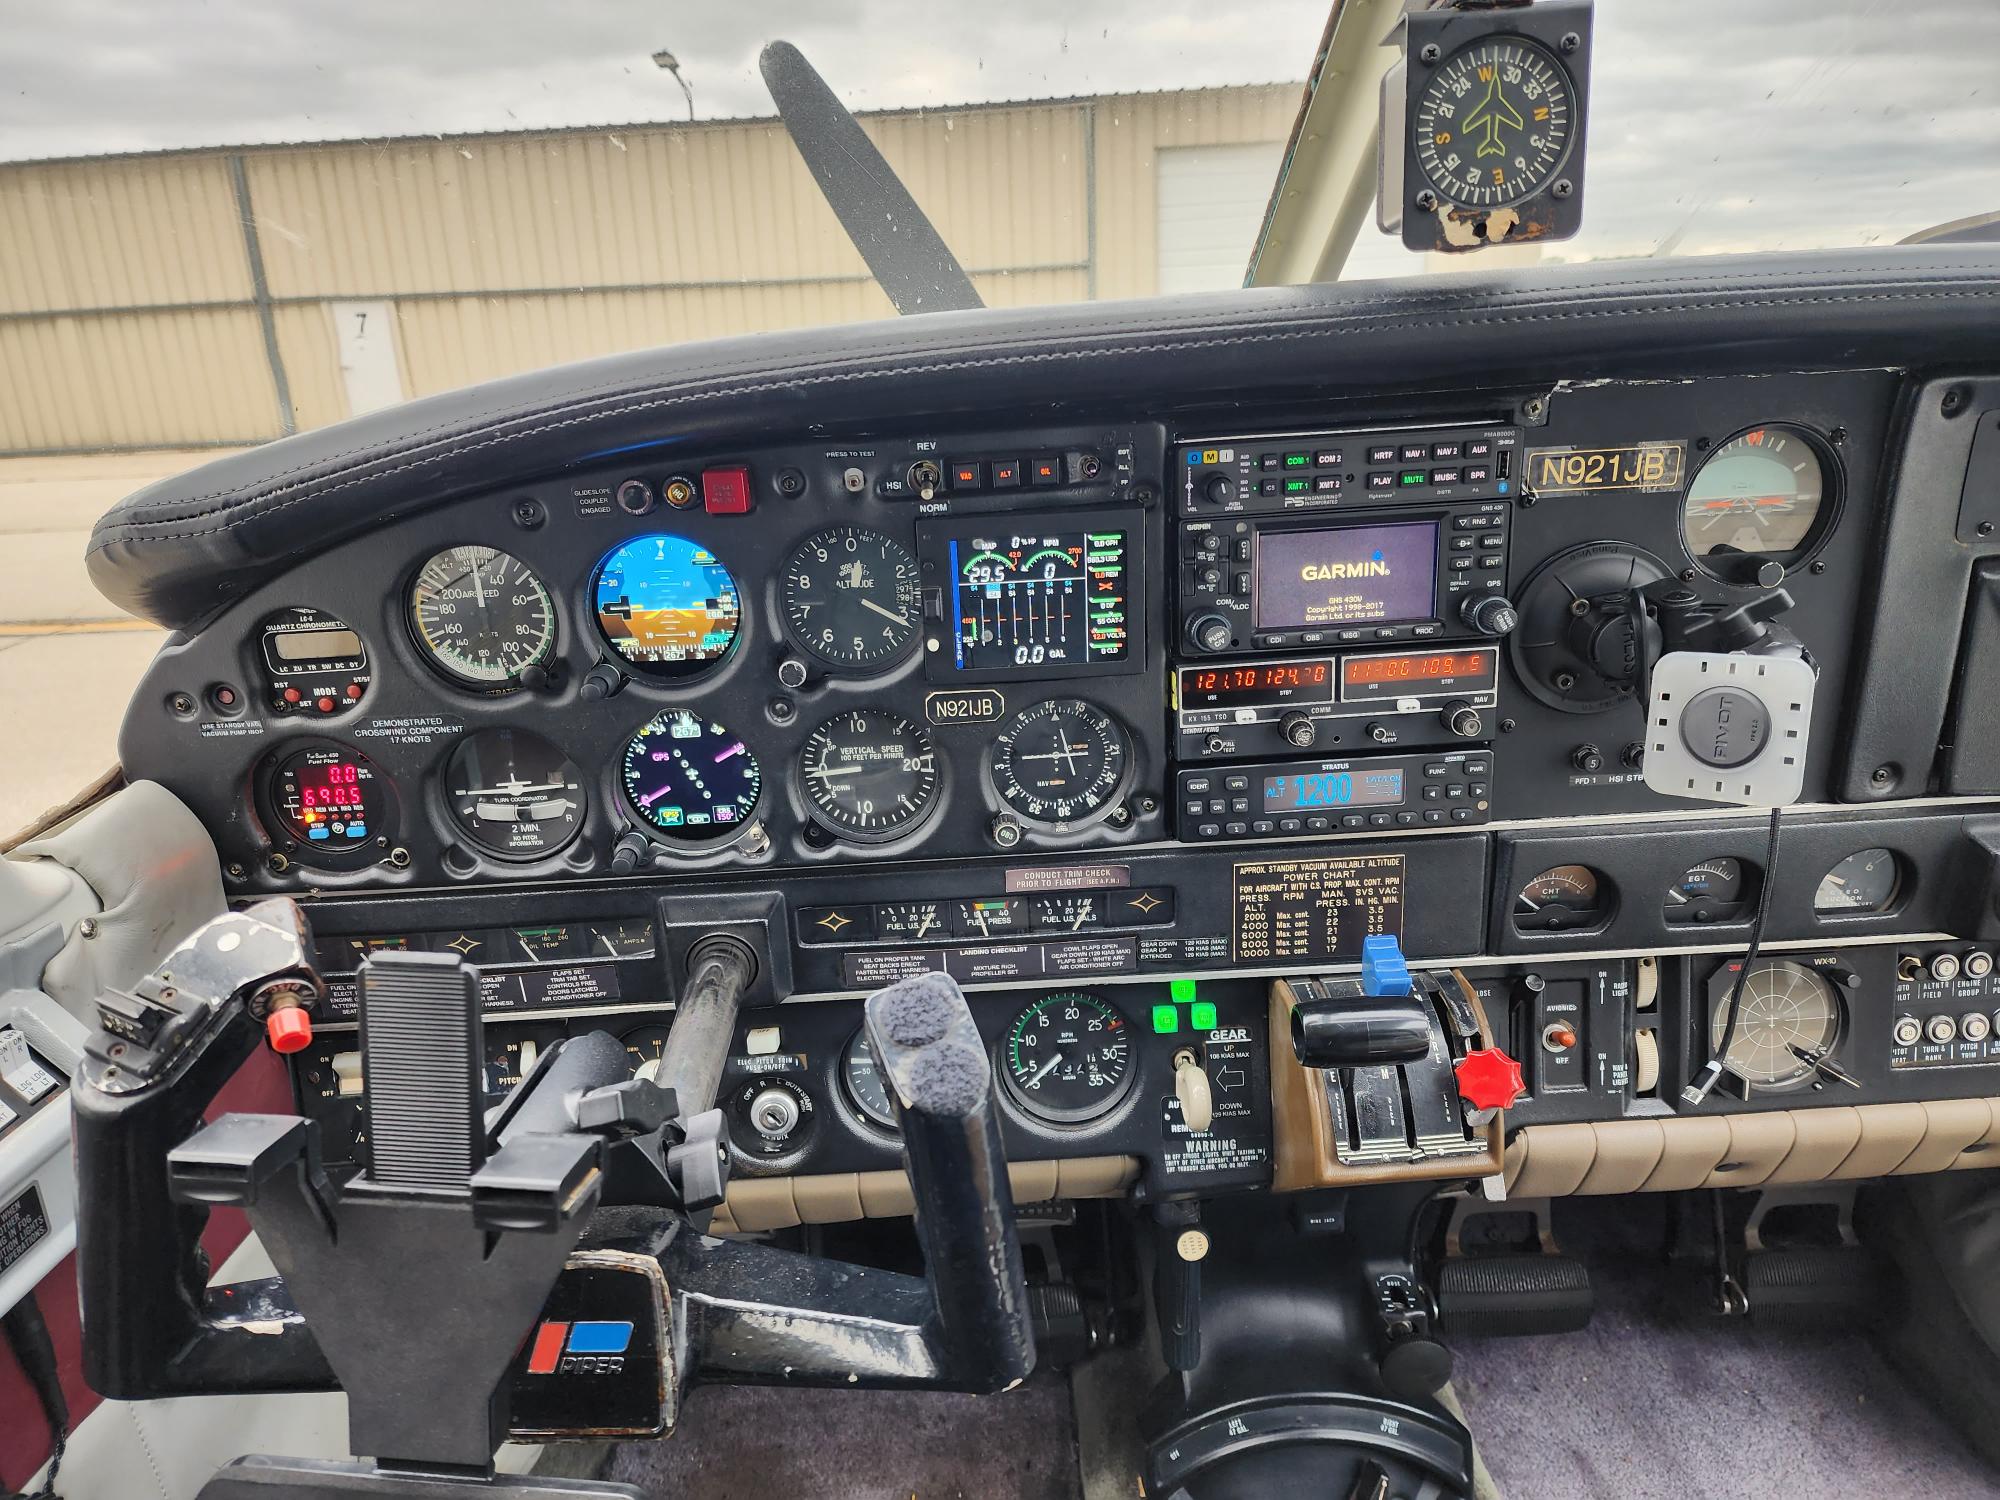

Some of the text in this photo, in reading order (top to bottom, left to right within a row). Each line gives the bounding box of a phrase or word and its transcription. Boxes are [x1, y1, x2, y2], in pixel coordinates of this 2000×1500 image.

[1478, 67, 1493, 82] W
[1503, 67, 1522, 84] 30
[1452, 78, 1472, 98] 24
[1523, 79, 1542, 100] 33
[1439, 102, 1455, 119] 21
[1534, 108, 1549, 121] N
[1436, 132, 1450, 145] S
[917, 442, 936, 450] REV
[1472, 446, 1488, 454] AUX
[1374, 452, 1393, 460] HRTF
[1437, 448, 1452, 456] NAV
[1319, 456, 1336, 464] COM
[1542, 452, 1666, 486] N921JB
[1404, 476, 1424, 484] MUTE
[1471, 471, 1486, 479] SPR
[887, 481, 902, 490] HSI
[1374, 477, 1392, 485] PLAY
[920, 504, 948, 513] NORM
[969, 567, 1005, 583] 29.5
[1302, 561, 1385, 580] GARMIN
[442, 589, 463, 600] 200
[512, 596, 527, 606] 60
[439, 604, 456, 614] 180
[1307, 605, 1342, 613] Copyright
[445, 623, 462, 633] 160
[1416, 627, 1434, 635] PROC
[1306, 634, 1320, 642] OBS
[1343, 631, 1358, 639] MSG
[1015, 646, 1066, 664] 0.0 GAL
[313, 688, 337, 696] MODE
[373, 718, 443, 728] DEMONSTRATED
[850, 719, 866, 733] 10
[355, 726, 464, 737] CROSSWIND COMPONENT
[1713, 696, 1733, 761] PIVOT
[840, 747, 877, 755] VERTICAL
[652, 753, 670, 762] GPS
[903, 758, 921, 772] 20
[330, 767, 355, 783] 0.0
[1267, 789, 1286, 798] ALT
[1294, 772, 1352, 806] 1200
[305, 787, 360, 806] 690.5
[1240, 858, 1400, 875] APPROX. STANDBY VACUUM AVAILABLE ALTITUDE
[1025, 872, 1061, 880] CONDUCT
[1086, 869, 1111, 877] CHECK
[1284, 870, 1356, 881] POWER CHART
[1688, 875, 1706, 883] EGT
[1056, 878, 1082, 886] FLIGHT
[1256, 884, 1288, 892] AIRCRAFT
[1385, 877, 1400, 885] RPM
[1240, 895, 1271, 903] PRESS.
[1283, 893, 1304, 901] RPM
[1322, 890, 1345, 898] MAN.
[1542, 888, 1560, 896] CHT
[1245, 904, 1266, 912] ALT.
[1316, 899, 1350, 908] PRESS.
[1355, 898, 1365, 906] IN.
[1383, 896, 1399, 904] MIN.
[1328, 909, 1338, 917] 23
[959, 948, 990, 956] LANDING
[1814, 957, 1837, 966] WX-10
[1958, 989, 1979, 997] GROUP
[1547, 1004, 1577, 1012] AVIONICS
[1065, 1008, 1080, 1020] 20
[1039, 1016, 1050, 1028] 15
[1210, 1029, 1247, 1040] GEAR
[1025, 1035, 1037, 1047] 10
[1923, 1045, 1937, 1053] TURN
[1220, 1102, 1242, 1110] DOWN
[1186, 1139, 1237, 1153] WARNING
[559, 1356, 625, 1375] PIPER
